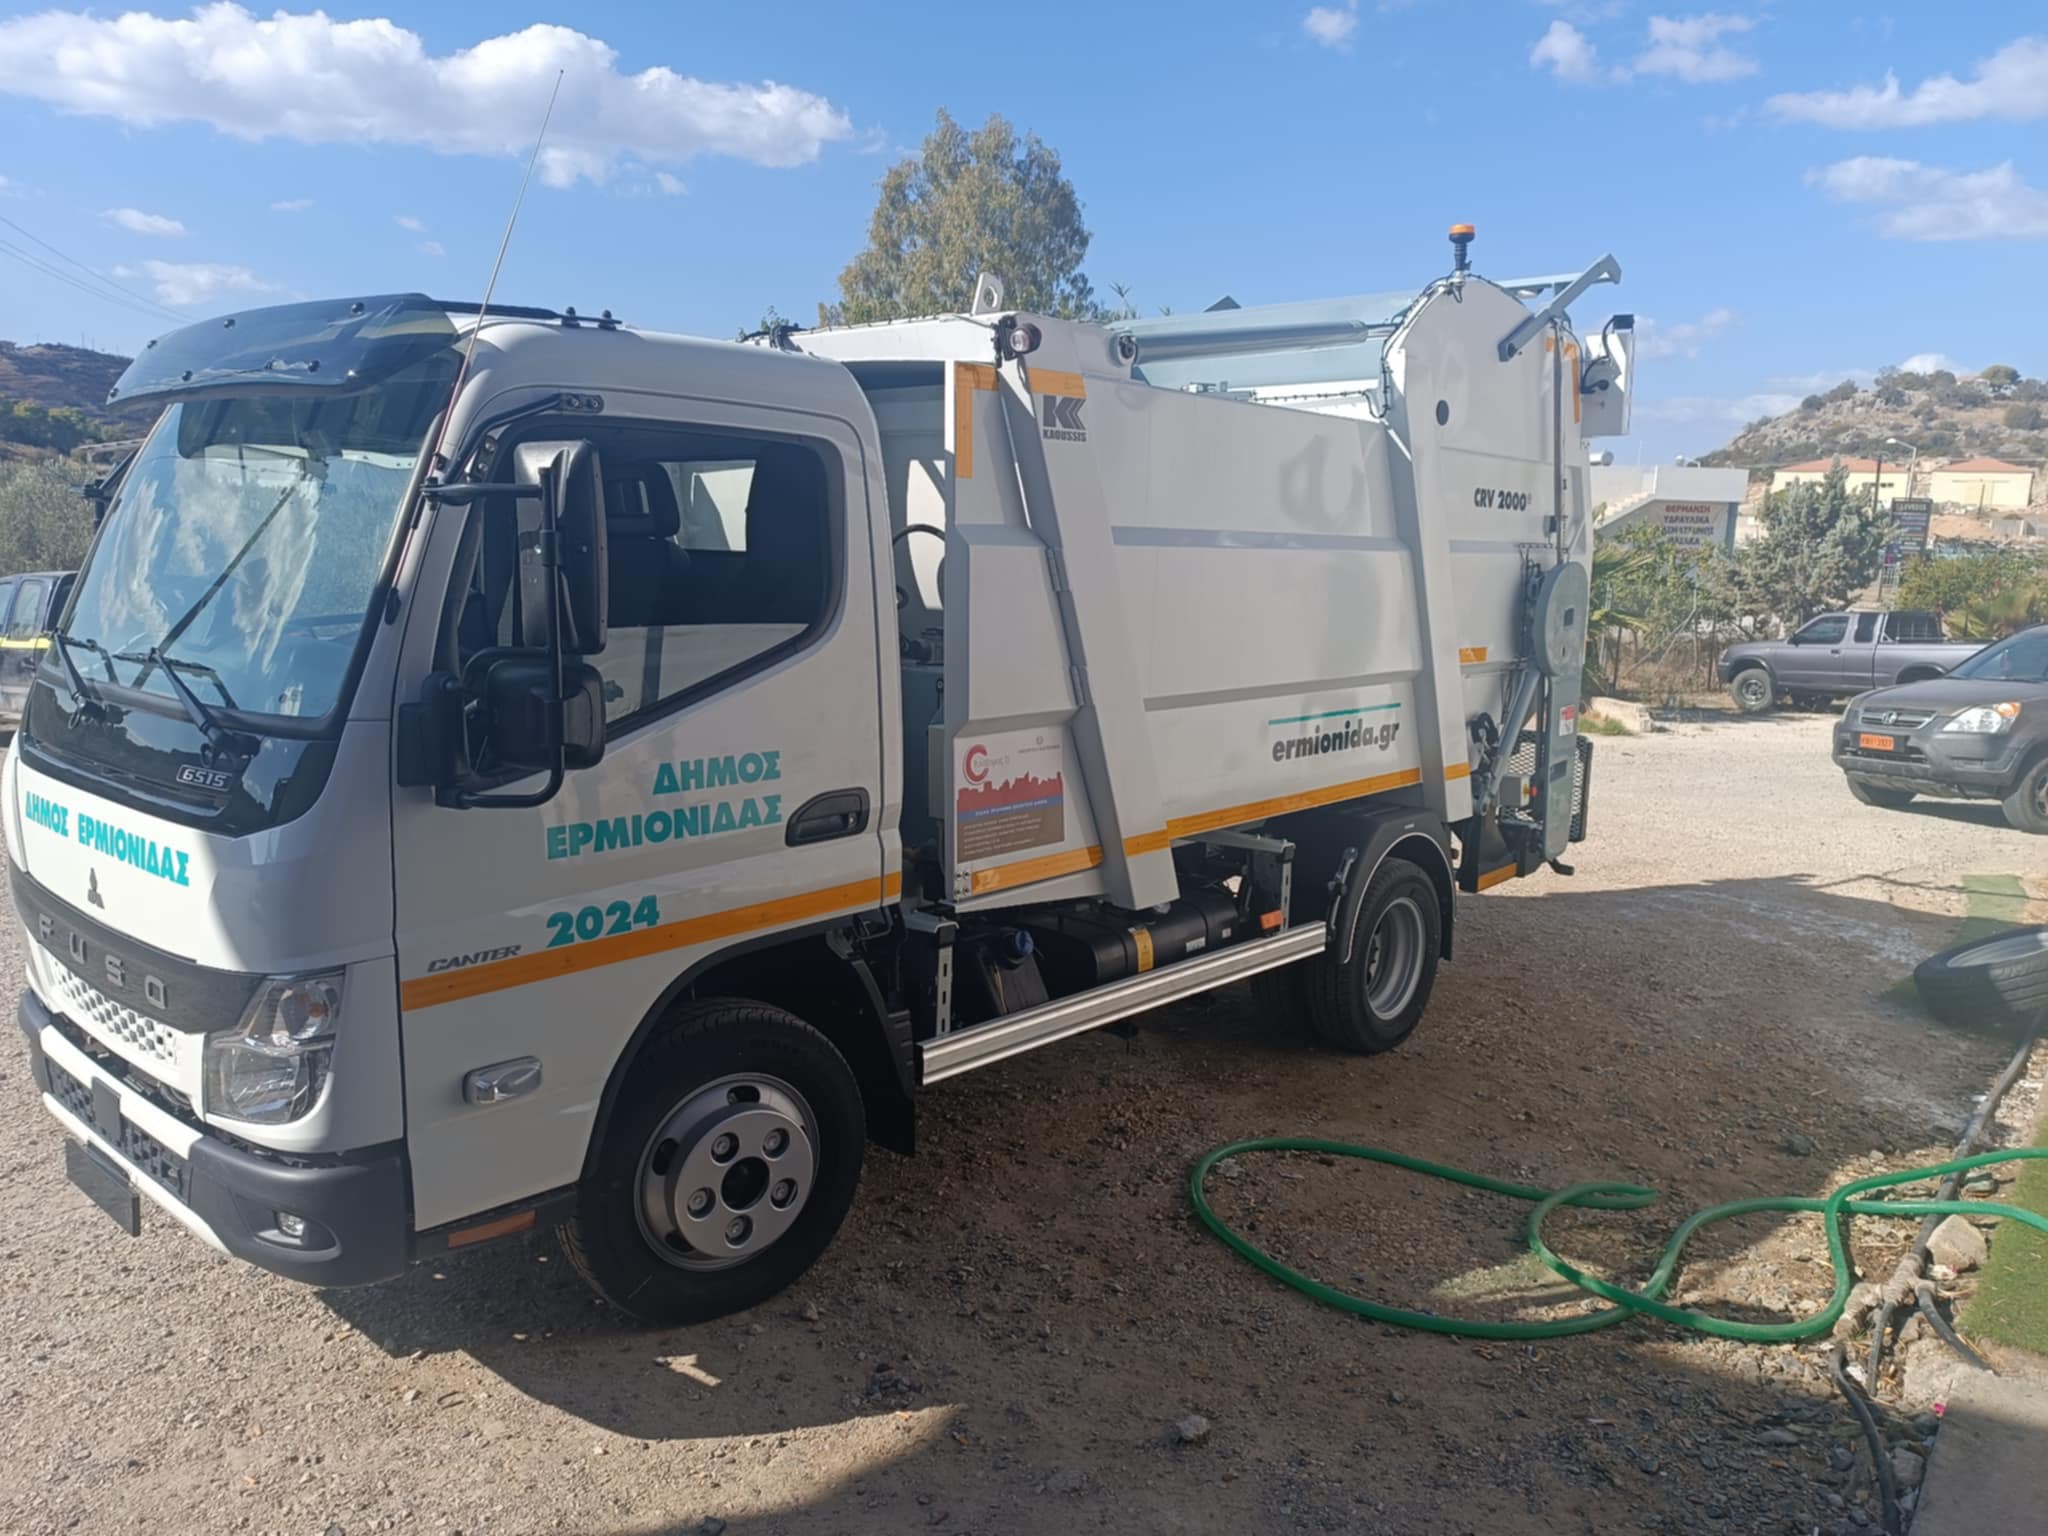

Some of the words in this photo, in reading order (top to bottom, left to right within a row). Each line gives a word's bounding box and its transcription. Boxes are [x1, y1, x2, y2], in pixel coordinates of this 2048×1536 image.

[1042, 428, 1087, 443] KAOUSSIS
[1473, 487, 1496, 509] CRV
[1498, 490, 1527, 511] 2000
[1271, 718, 1400, 762] ermionida.gr
[652, 750, 781, 795] ΔΗΜΟΣ
[25, 790, 69, 838] ΔΗΜΟΣ
[77, 811, 190, 887] ΕΡΜΙΟΝΙΔΑΣ
[546, 794, 783, 860] ΕΡΜΙΟΝΙΔΑΣ
[546, 894, 661, 949] 2024
[39, 912, 168, 1010] FUSO
[427, 944, 522, 973] CANTER
